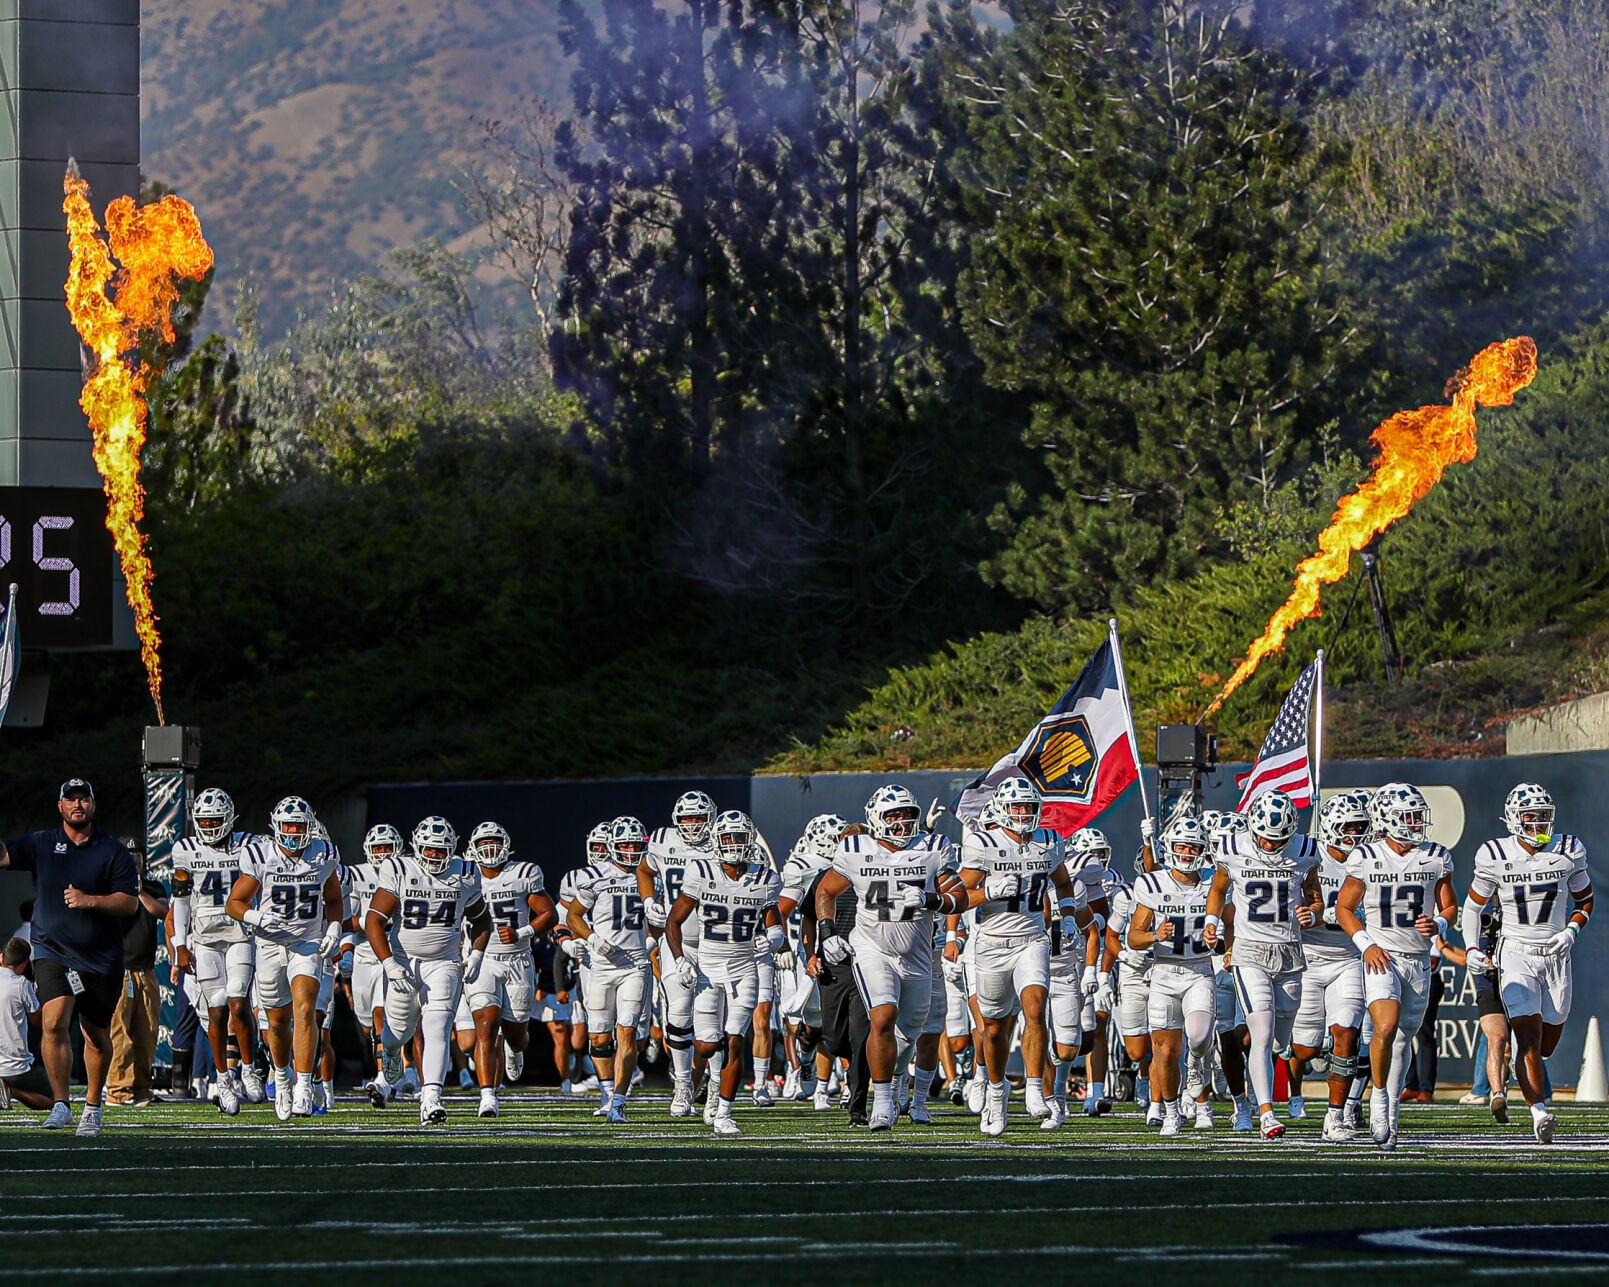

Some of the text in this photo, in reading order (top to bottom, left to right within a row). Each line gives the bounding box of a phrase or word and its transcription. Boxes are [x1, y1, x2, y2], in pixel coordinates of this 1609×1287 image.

[190, 859, 240, 869] UTAH STAT
[663, 856, 687, 866] UTAH
[994, 860, 1052, 872] UTAH STATE
[860, 865, 927, 877] UTAH STATE
[1241, 869, 1295, 879] UTAH STATE
[1369, 871, 1435, 883] UTAH STATE
[1502, 869, 1566, 883] UTAH STATE
[273, 874, 320, 883] UTAH STATE
[1318, 875, 1339, 888] TAH
[200, 870, 240, 907] 4
[607, 886, 629, 894] UTAH
[665, 867, 685, 905] 6
[405, 889, 462, 899] UTAH STATE
[490, 890, 518, 900] STATE
[701, 891, 763, 906] UTAH STATE
[865, 880, 927, 922] 47
[271, 883, 322, 920] 95
[1244, 880, 1289, 923] 21
[1380, 884, 1425, 929] 13
[1512, 882, 1559, 925] 17
[402, 899, 456, 930] 94
[492, 898, 520, 929] 5
[612, 894, 646, 931] 15
[1158, 904, 1207, 914] UTAH STA
[702, 903, 758, 943] 26
